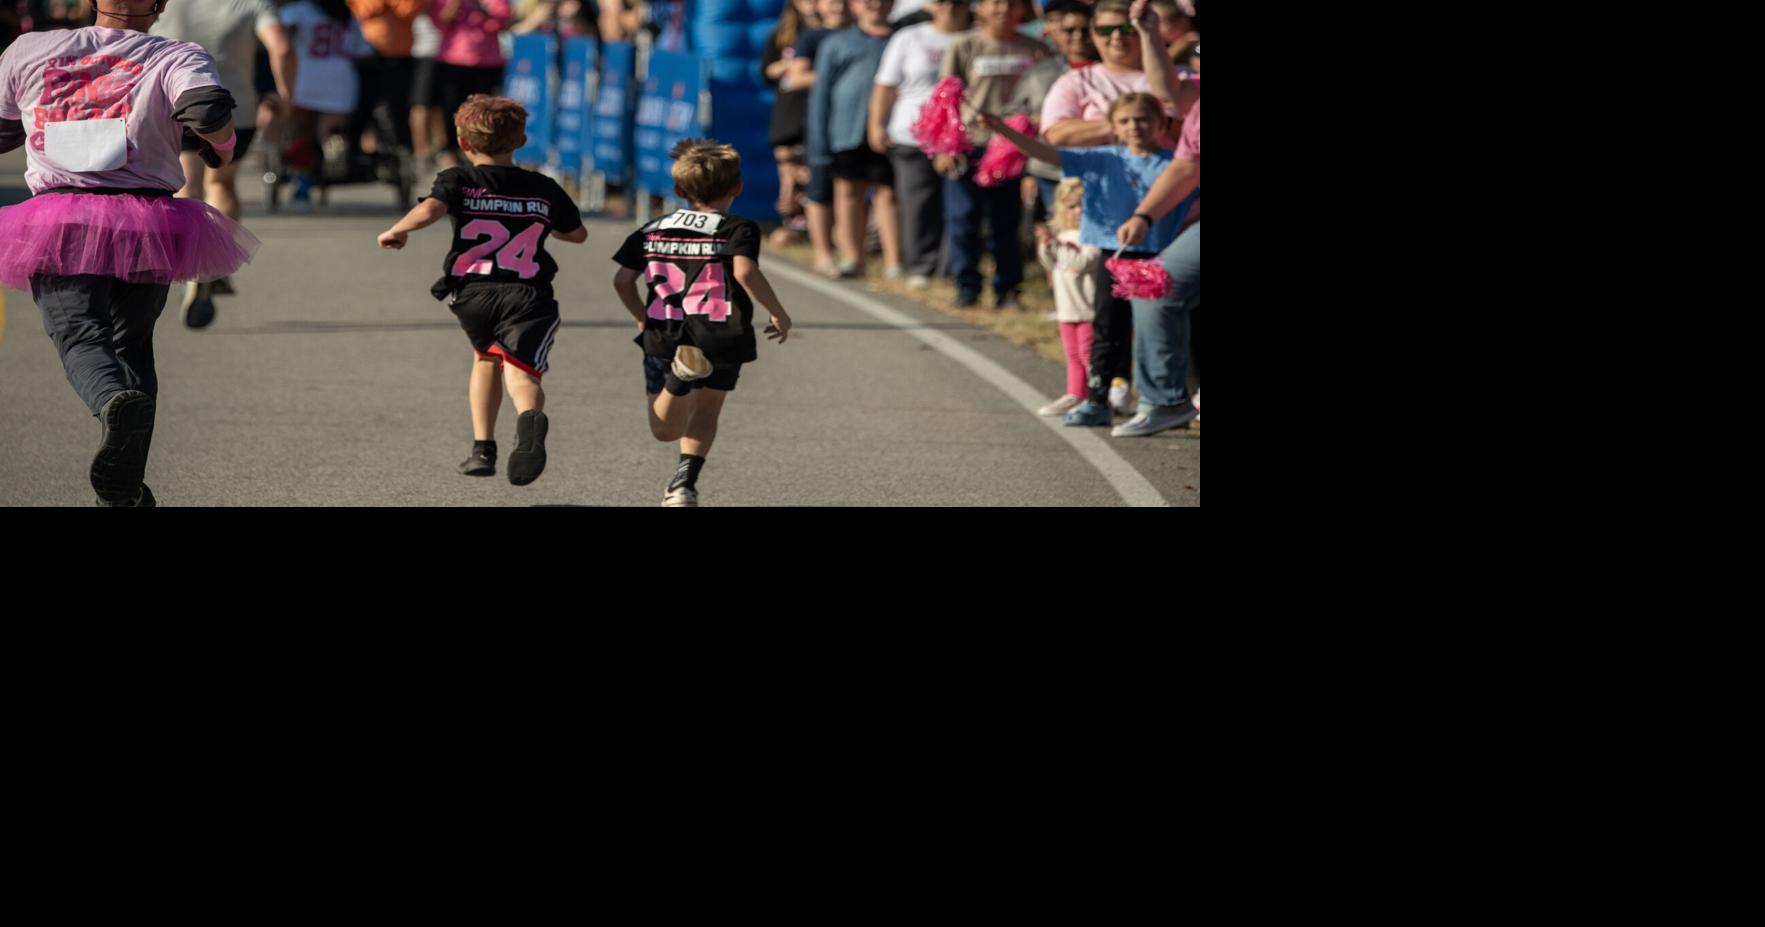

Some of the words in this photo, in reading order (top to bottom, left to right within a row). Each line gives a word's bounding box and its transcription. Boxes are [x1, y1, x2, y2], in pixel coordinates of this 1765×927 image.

[451, 218, 545, 279] 24
[673, 212, 708, 229] 703
[644, 260, 732, 322] 24
